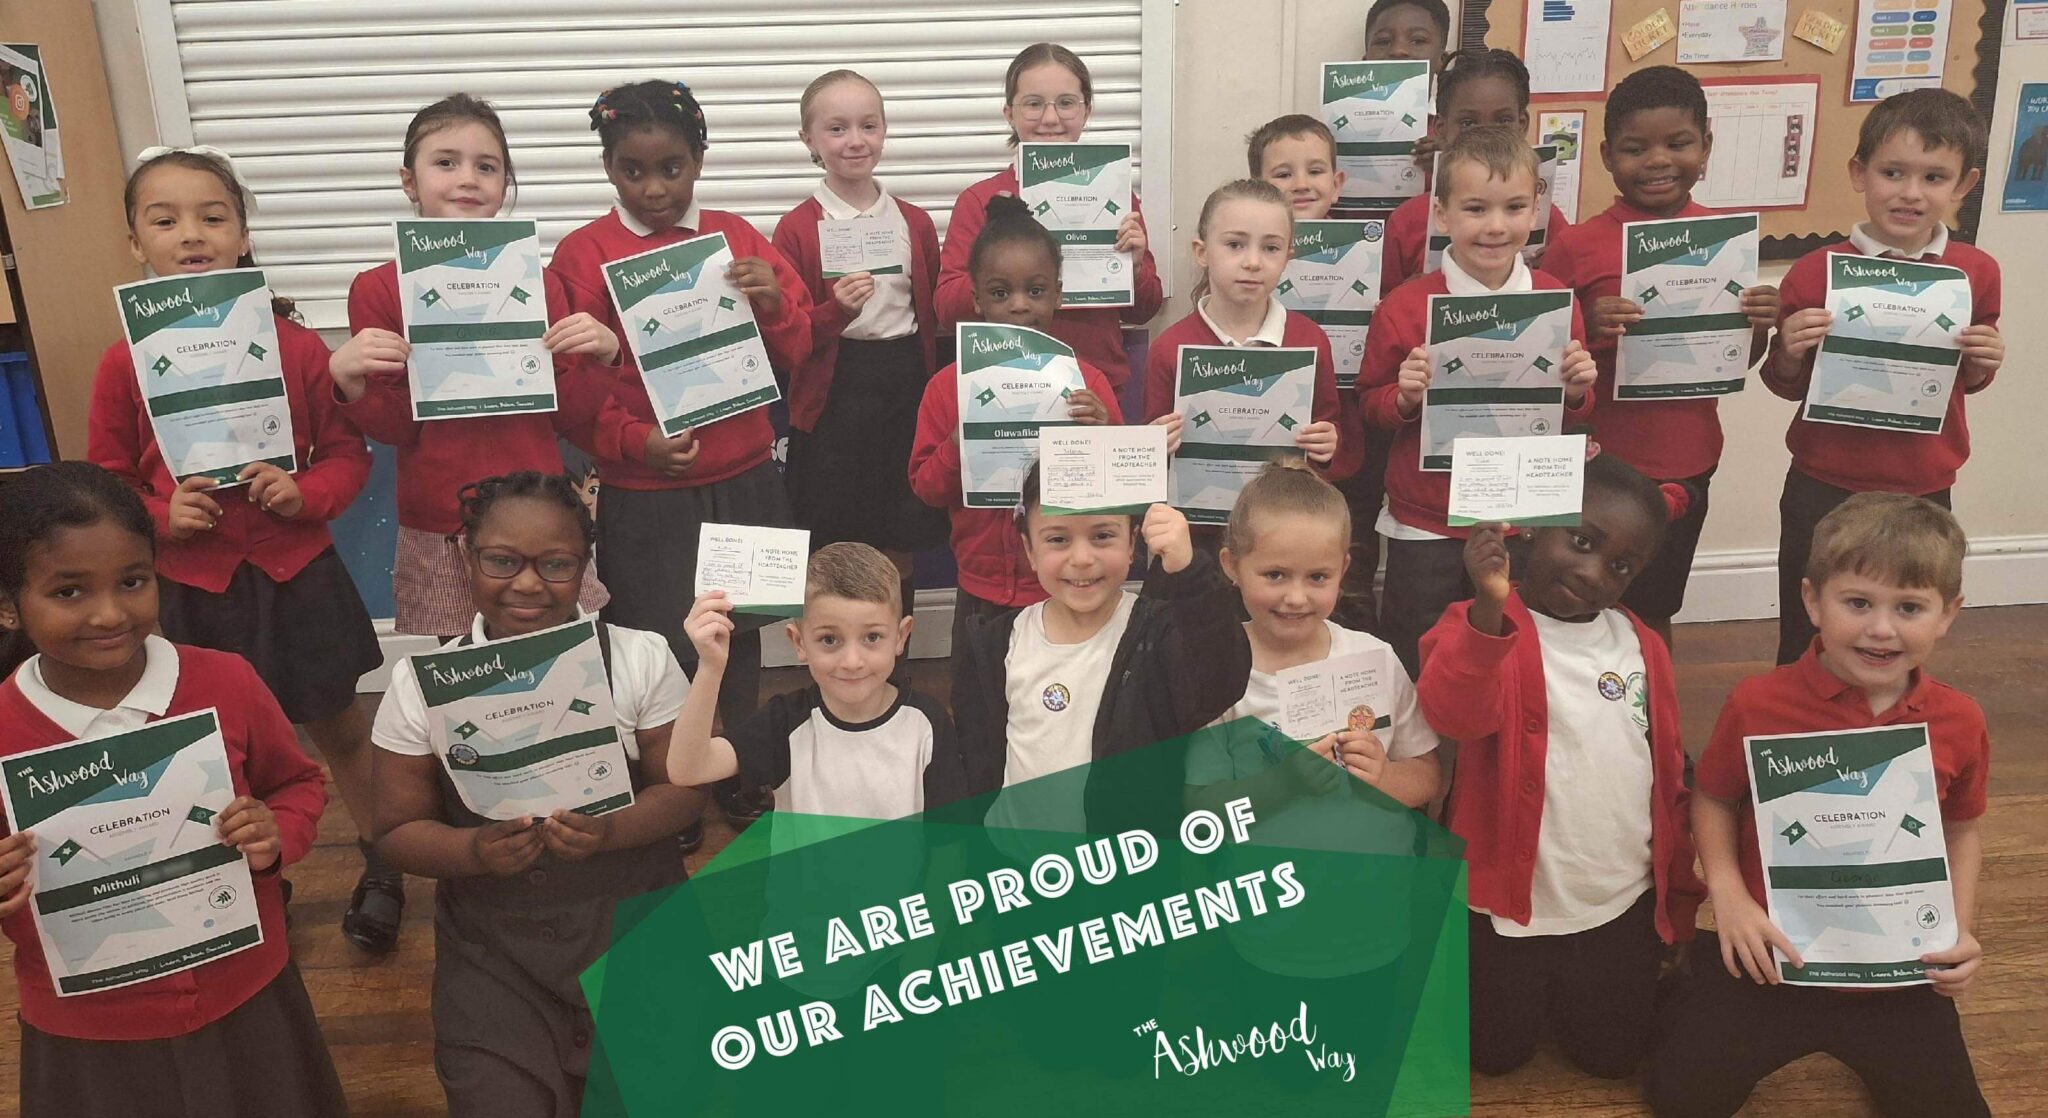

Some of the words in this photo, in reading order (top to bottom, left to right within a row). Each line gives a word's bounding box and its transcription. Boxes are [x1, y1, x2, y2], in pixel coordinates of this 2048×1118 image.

[1332, 70, 1374, 88] Ashwood
[1372, 83, 1388, 96] Way
[1032, 152, 1075, 171] Ashwood
[1073, 166, 1090, 181] Way
[411, 230, 466, 252] Ashwood
[1638, 229, 1691, 254] Ashwood
[465, 246, 488, 264] Way
[1320, 244, 1338, 259] Way
[1688, 244, 1708, 260] Way
[622, 258, 670, 290] Ashwood
[670, 270, 692, 284] Way
[1843, 264, 1898, 277] Ashwood
[1666, 277, 1716, 286] CELEBRATION
[1896, 278, 1917, 292] Way
[134, 288, 193, 319] Ashwood
[193, 304, 220, 321] Way
[662, 297, 709, 315] CELEBRATION
[1873, 302, 1926, 314] CELEBRATION
[1443, 304, 1499, 326] Ashwood
[1496, 320, 1516, 336] Way
[177, 340, 237, 354] CELEBRATION
[972, 336, 1023, 354] Ashwood
[1022, 350, 1041, 366] Way
[1192, 359, 1246, 378] Ashwood
[1243, 376, 1263, 391] Way
[433, 654, 505, 686] Ashwood
[504, 668, 535, 684] Way
[485, 700, 554, 721] CELEBRATION
[1767, 747, 1839, 777] Ashwood
[17, 766, 33, 778] THE
[28, 751, 114, 798] Ashwood
[113, 768, 148, 788] Way
[1837, 768, 1868, 788] Way
[90, 808, 170, 835] CELEBRATION
[1814, 812, 1886, 822] CELEBRATION
[93, 875, 141, 895] Mithuli
